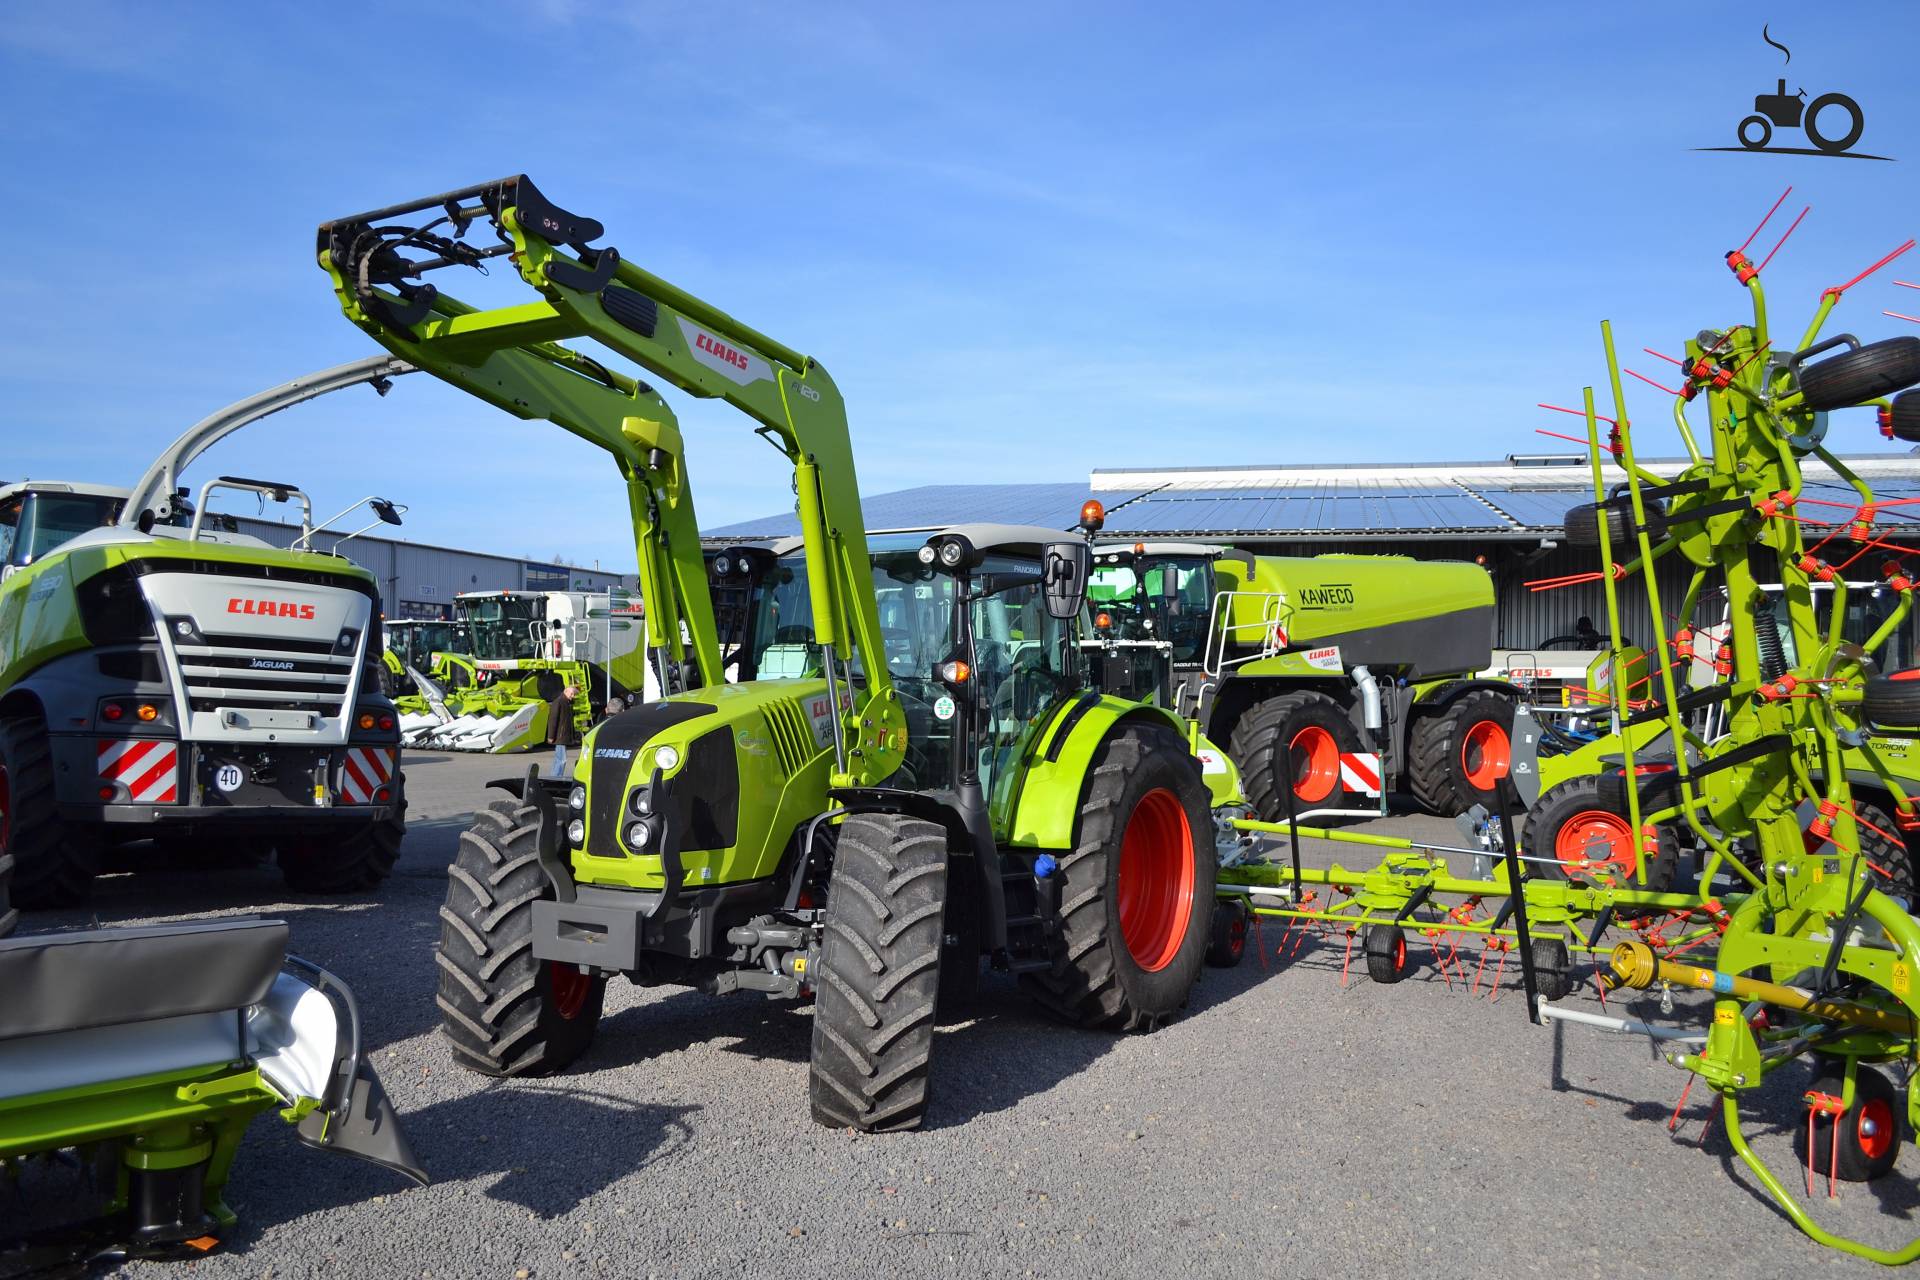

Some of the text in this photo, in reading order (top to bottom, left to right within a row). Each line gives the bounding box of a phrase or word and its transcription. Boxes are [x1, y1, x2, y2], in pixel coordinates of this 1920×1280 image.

[695, 333, 749, 371] CLAAS
[1299, 588, 1354, 605] KAWECO
[227, 598, 316, 620] CLAAS
[1309, 649, 1336, 660] CLAAS
[248, 657, 294, 670] JAGUAR
[594, 748, 632, 759] CLAAS
[1871, 742, 1907, 752] TORION
[220, 769, 238, 786] 40
